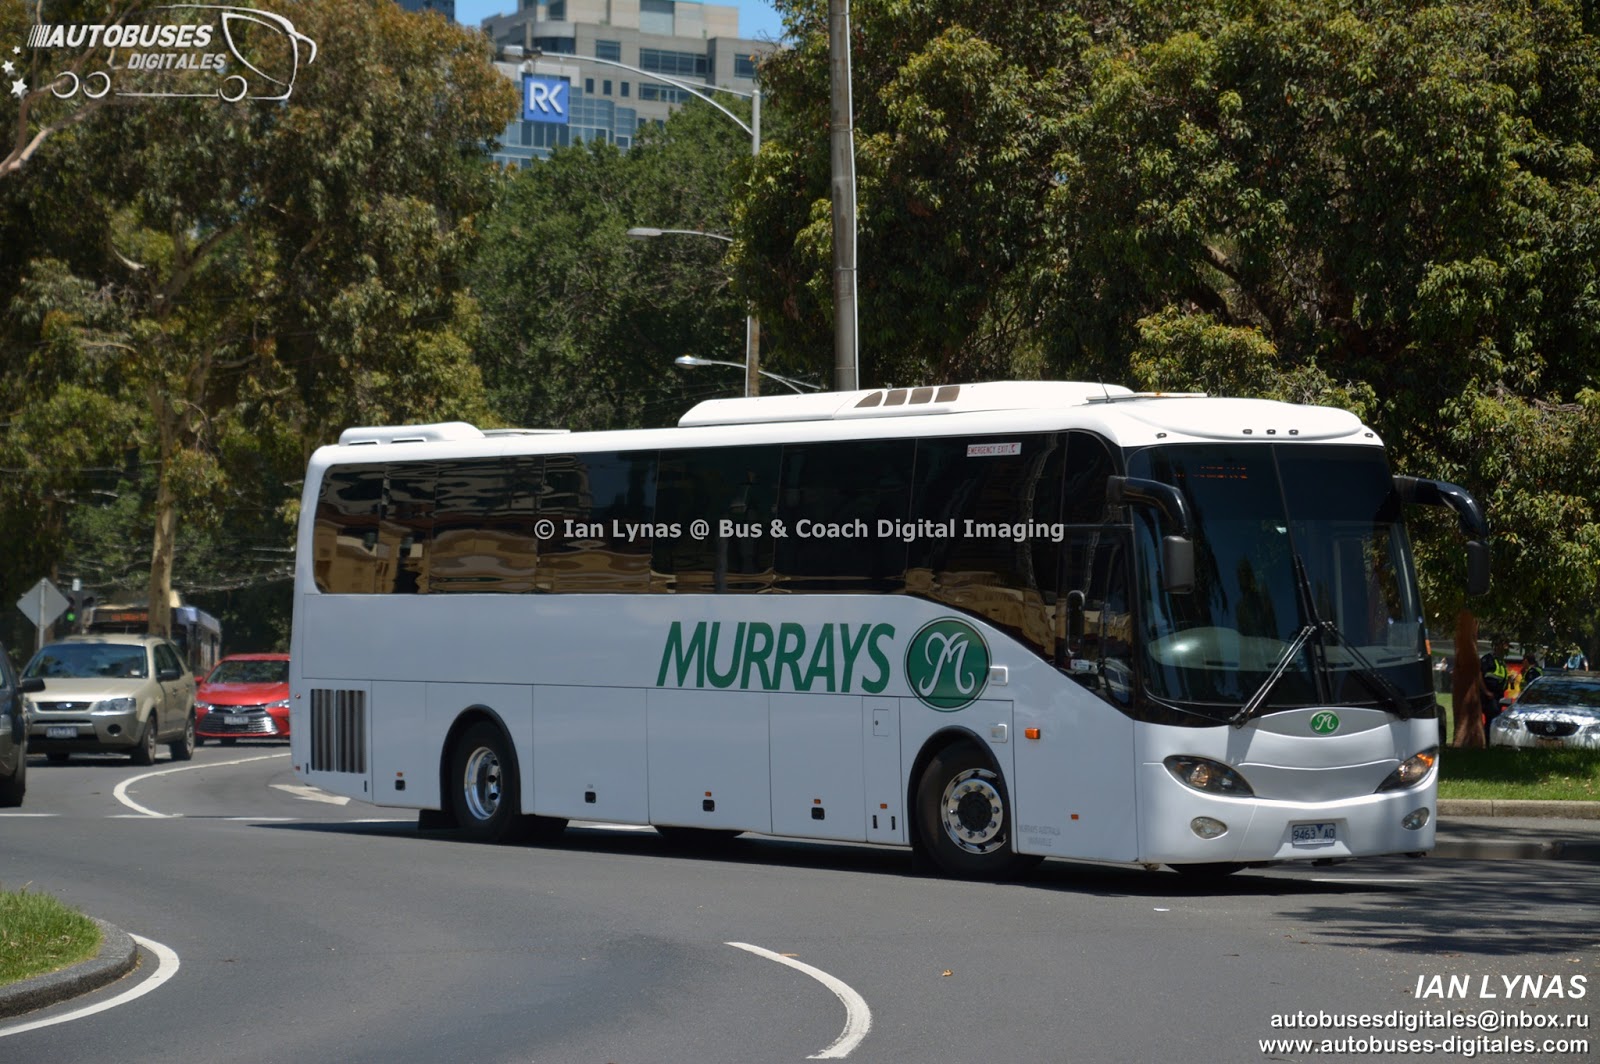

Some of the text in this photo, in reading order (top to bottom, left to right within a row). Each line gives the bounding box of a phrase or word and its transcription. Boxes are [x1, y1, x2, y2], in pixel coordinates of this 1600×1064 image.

[529, 81, 564, 114] RK
[655, 620, 896, 694] MURRAYS
[1293, 829, 1316, 840] 9463
